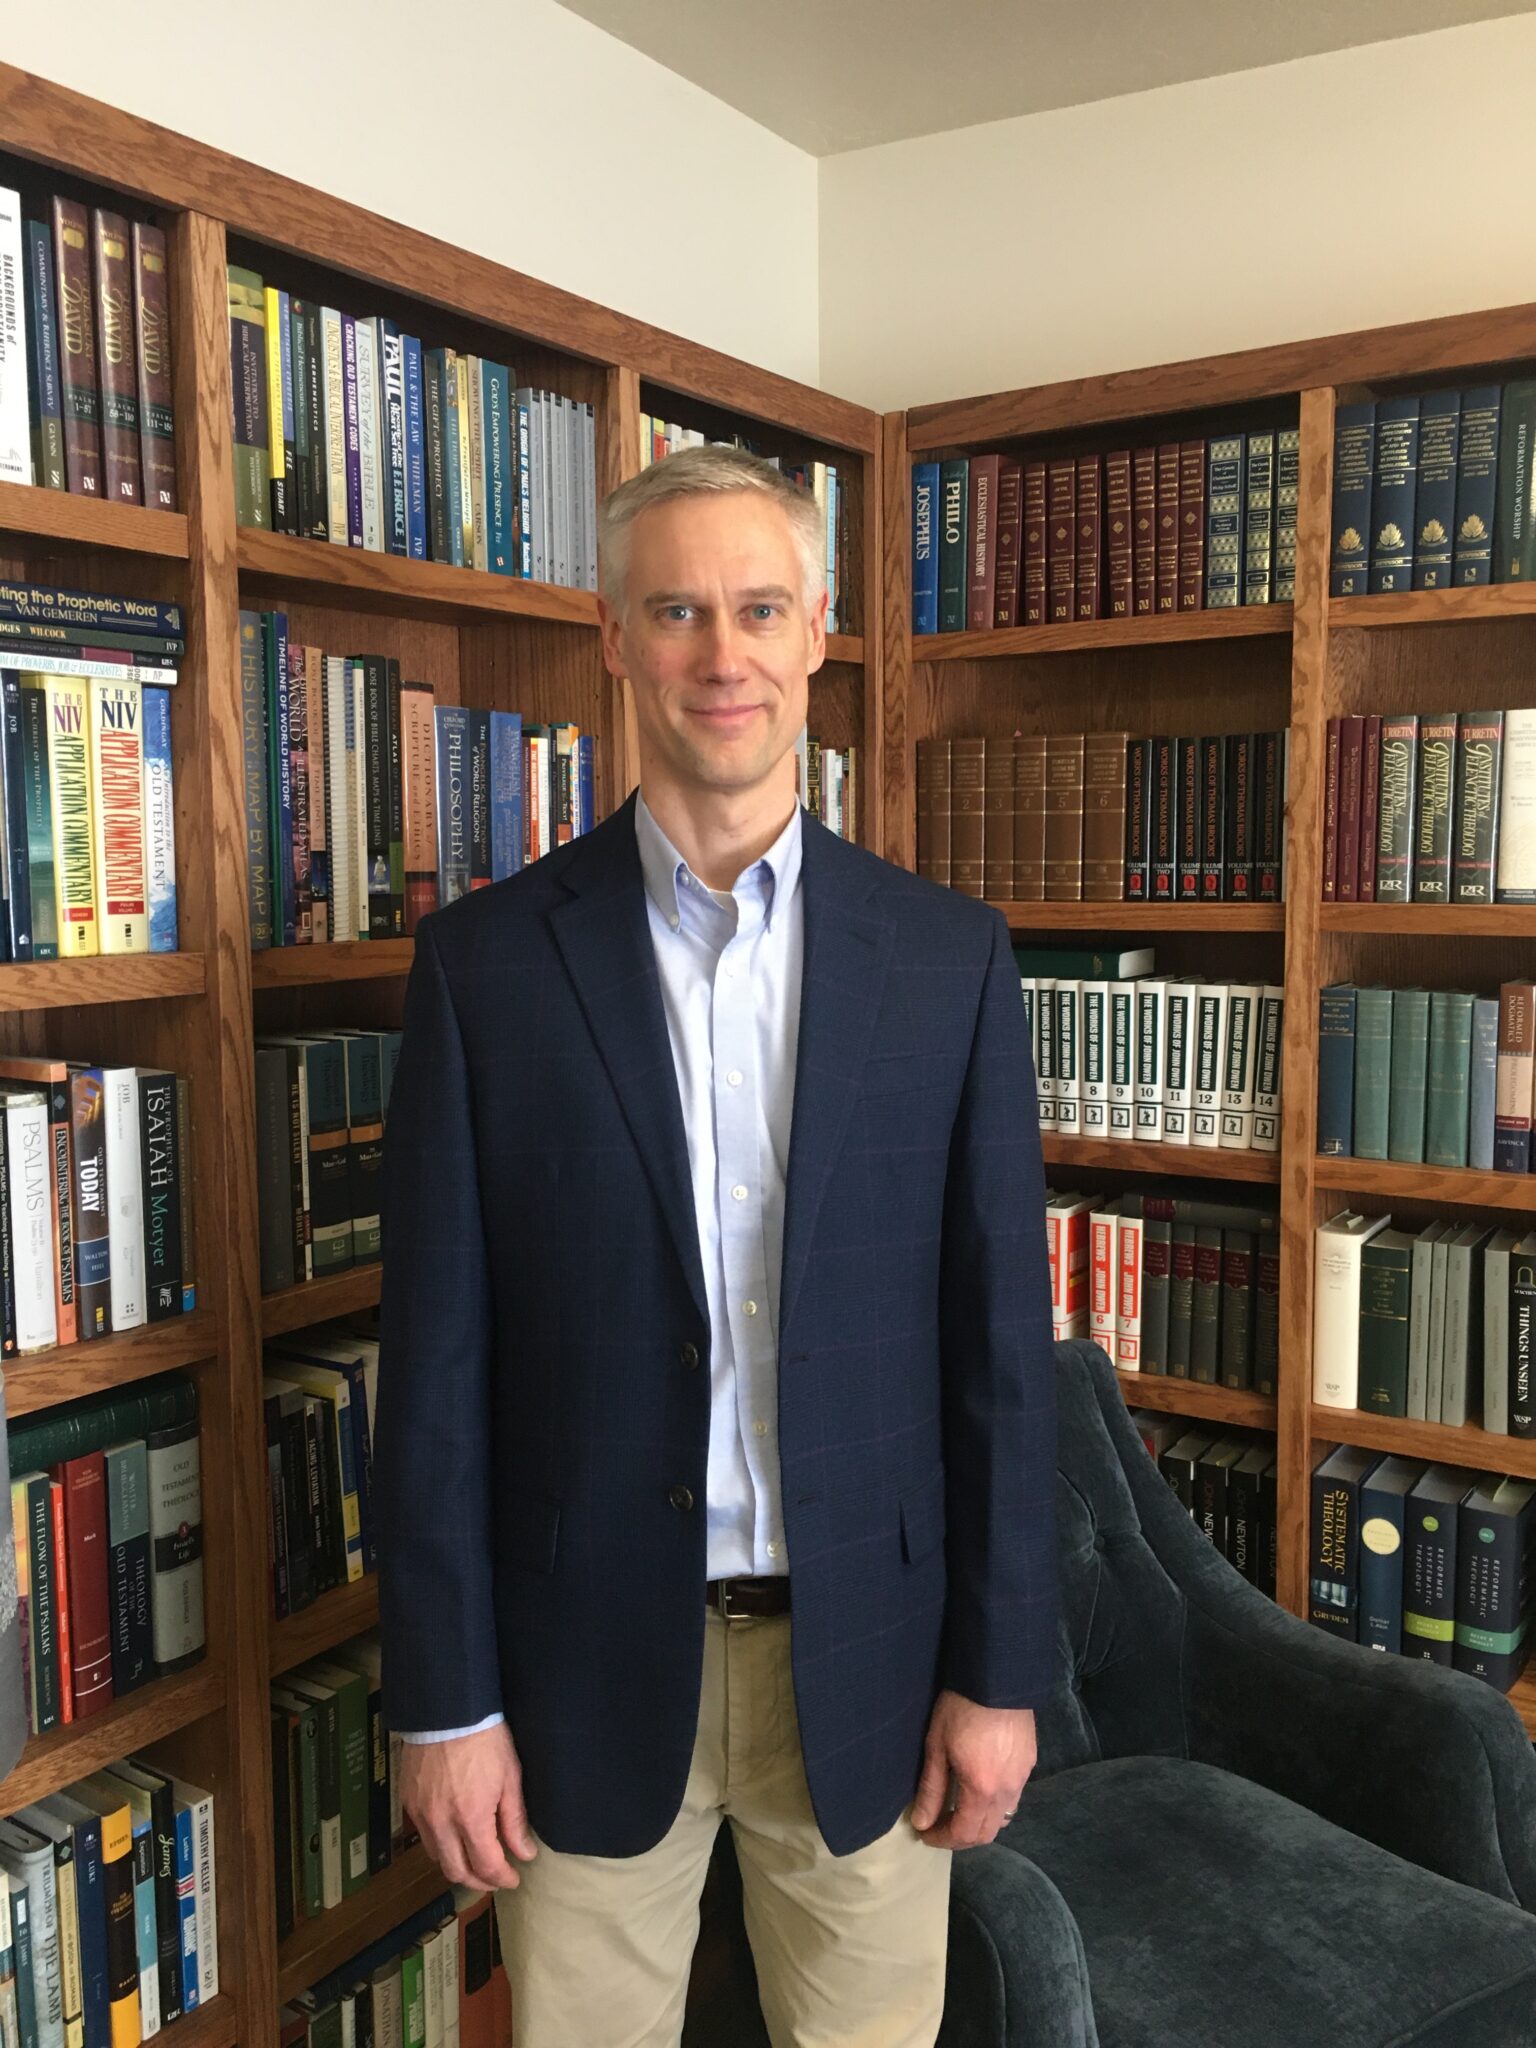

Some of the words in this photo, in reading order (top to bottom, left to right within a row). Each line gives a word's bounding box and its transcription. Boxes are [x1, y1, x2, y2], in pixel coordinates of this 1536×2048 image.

[60, 272, 83, 354] DAVID
[101, 283, 123, 364] DAVID
[140, 296, 162, 375] DAVID
[344, 323, 355, 362] CRACKING
[347, 364, 356, 379] OLD
[409, 351, 417, 381] PAUL
[347, 382, 358, 425] TESTAMENT
[410, 384, 417, 392] &
[108, 408, 135, 423] 58-110
[410, 394, 419, 418] THE
[350, 427, 359, 452] CODES
[411, 420, 420, 446] LAW
[285, 450, 293, 470] FEE
[1517, 423, 1526, 494] REFORMATION
[276, 480, 285, 517] STUART
[412, 452, 421, 515] THIELMAN
[916, 485, 931, 560] JOSEPHUS
[946, 481, 962, 544] PHILO
[977, 477, 988, 541] ECCLESIASTICAL
[1512, 494, 1524, 540] WORSHIP
[414, 537, 423, 556] IVP
[976, 543, 987, 578] HISTORY
[16, 604, 40, 617] VAN
[42, 608, 99, 624] GEMEREN
[31, 591, 54, 605] the
[57, 594, 122, 614] Prophetic
[123, 600, 159, 618] Word
[279, 636, 288, 692] TIMELINE
[53, 692, 83, 706] THE
[100, 687, 139, 700] THE
[243, 654, 258, 756] HISTORY
[281, 694, 288, 710] OF
[289, 678, 302, 742] WORLD
[8, 714, 17, 734] JOB
[53, 704, 83, 734] NIV
[99, 700, 137, 730] NIV
[160, 698, 169, 749] GOLDINGAY
[280, 712, 289, 756] WORLD
[411, 703, 420, 778] SCRIPTURE
[479, 725, 487, 741] THE
[1462, 727, 1499, 740] TURRETIN
[53, 734, 89, 816] APPLICATION
[100, 730, 141, 812] APPLICATION
[423, 723, 433, 829] DICTIONARY
[479, 742, 488, 803] EVANGELICAL
[1160, 746, 1169, 776] WORKS
[1208, 744, 1217, 774] WORKS
[151, 763, 162, 796] OLD
[281, 759, 290, 810] HISTORY
[1160, 777, 1169, 788] OF
[1208, 775, 1217, 787] OF
[1381, 753, 1396, 803] ELENCTIC
[1422, 753, 1437, 803] ELENCTIC
[1463, 756, 1478, 807] ELENCTIC
[247, 771, 263, 823] MAP
[447, 733, 463, 859] PHILOSOPHY
[1160, 789, 1169, 824] THOMAS
[1208, 788, 1217, 823] THOMAS
[153, 802, 167, 889] TESTAMENT
[250, 829, 264, 856] BY
[412, 809, 421, 861] ETHICS
[480, 805, 488, 865] DICTIONARY
[1160, 824, 1169, 857] BROOKS
[1208, 824, 1217, 857] BROOKS
[1380, 803, 1394, 855] THEOLOGY
[1420, 803, 1436, 856] THEOLOGY
[1461, 806, 1478, 859] THEOLOGY
[62, 818, 93, 905] COMMENTARY
[103, 814, 145, 899] COMMENTARY
[252, 865, 266, 915] MAP
[1089, 994, 1099, 1008] THE
[1142, 994, 1153, 1008] THE
[1205, 1000, 1214, 1013] THE
[1089, 1008, 1099, 1034] WORKS
[1142, 1008, 1153, 1035] WORKS
[1203, 1014, 1213, 1040] WORKS
[1507, 995, 1517, 1044] DOGMATICS
[1517, 996, 1525, 1044] REFORMED
[1089, 1034, 1099, 1044] OF
[1089, 1043, 1099, 1061] JOHN
[1142, 1035, 1153, 1044] OF
[1142, 1044, 1153, 1062] JOHN
[1203, 1041, 1212, 1050] OF
[1089, 1061, 1099, 1081] OWEN
[1142, 1062, 1153, 1083] OWEN
[1202, 1050, 1211, 1068] JOHN
[291, 1083, 300, 1096] HE
[1042, 1080, 1050, 1091] 6
[1062, 1082, 1070, 1092] 7
[1089, 1085, 1098, 1096] 8
[1116, 1086, 1125, 1097] 9
[1140, 1087, 1154, 1098] 10
[1201, 1069, 1211, 1089] OWEN
[292, 1099, 300, 1109] IS
[1169, 1091, 1182, 1102] 11
[1198, 1093, 1213, 1104] 12
[1227, 1094, 1242, 1105] 13
[1259, 1097, 1273, 1107] 14
[292, 1111, 300, 1129] NOT
[147, 1087, 169, 1188] ISAIAH
[293, 1131, 301, 1165] SILENT
[22, 1121, 46, 1212] PSALMS
[56, 1130, 69, 1204] ENCOUNTERING
[79, 1156, 101, 1212] TODAY
[60, 1204, 69, 1218] THE
[61, 1221, 70, 1243] BOOK
[150, 1193, 169, 1267] Motyer
[1095, 1225, 1107, 1262] HEBREWS
[1123, 1229, 1135, 1266] HEBREWS
[62, 1256, 73, 1303] PSALMS
[1095, 1267, 1107, 1290] JOHN
[1123, 1271, 1135, 1294] JOHN
[1095, 1289, 1106, 1312] OWEN
[1122, 1293, 1134, 1316] OWEN
[1096, 1314, 1104, 1324] 6
[1124, 1318, 1132, 1328] 7
[1518, 1305, 1531, 1354] THINGS
[1517, 1355, 1529, 1402] UNSEEN
[172, 1460, 190, 1473] OLD
[35, 1498, 46, 1526] THE
[36, 1527, 49, 1561] FLOW
[1236, 1518, 1246, 1570] NEWTON
[1319, 1492, 1335, 1568] THEOLOGY
[1333, 1489, 1349, 1576] SYSTEMATIC
[38, 1563, 48, 1581] OF
[116, 1545, 127, 1574] OLD
[1415, 1543, 1423, 1594] THEOLOGY
[1425, 1545, 1434, 1607] SYSTEMATIC
[1436, 1547, 1445, 1600] REFORMED
[39, 1583, 50, 1610] THE
[135, 1555, 147, 1626] THEOLOGY
[1469, 1554, 1479, 1606] THEOLOGY
[1479, 1557, 1490, 1619] SYSTEMATIC
[1491, 1559, 1501, 1611] REFORMED
[118, 1578, 130, 1653] TESTAMENT
[1313, 1609, 1349, 1625] GRUDEM
[40, 1611, 51, 1656] PSALMS
[158, 1833, 175, 1878] James
[199, 1818, 210, 1860] TIMOTHY
[41, 1863, 52, 1913] TRIUMPH
[87, 1860, 96, 1885] LUKE
[200, 1861, 211, 1895] KELLER
[45, 1914, 54, 1929] OF
[44, 1932, 59, 1968] THE
[47, 1973, 62, 2025] LAMB
[380, 1980, 391, 2046] JONATHAN
